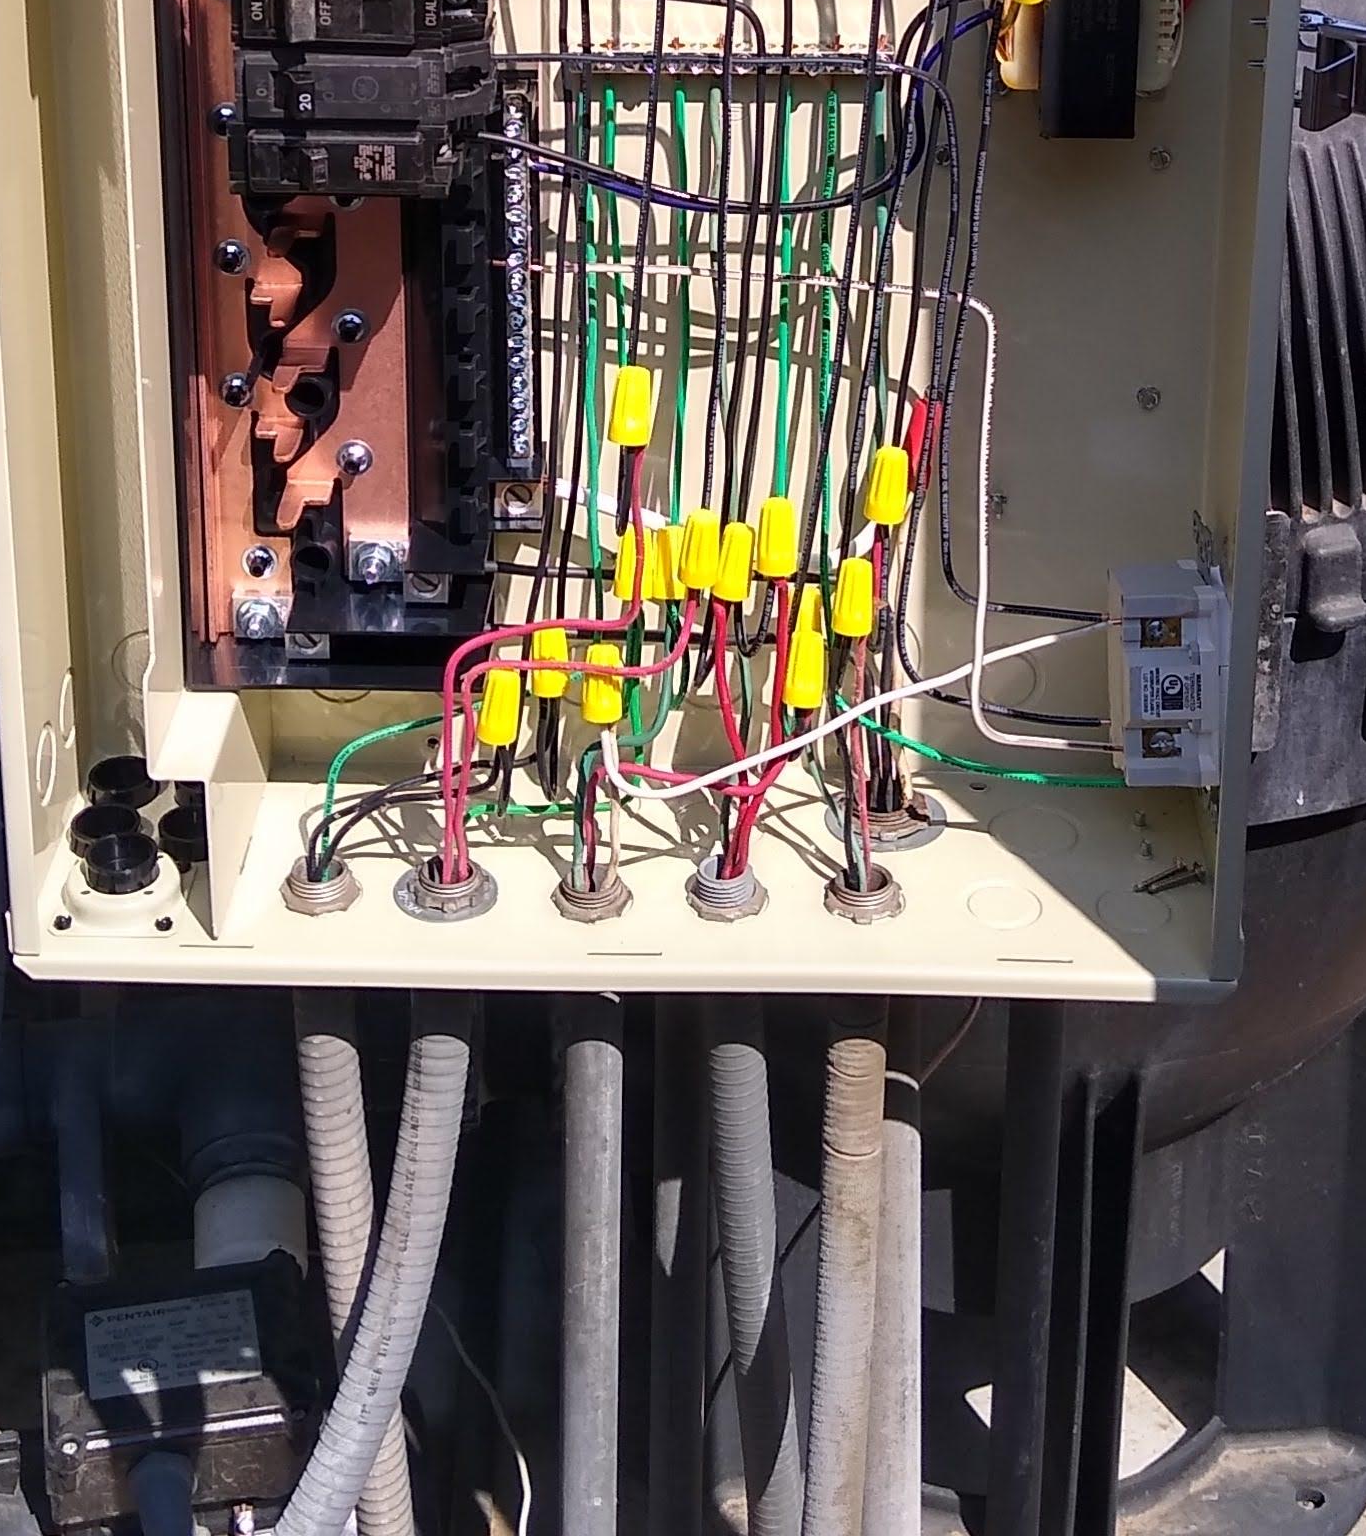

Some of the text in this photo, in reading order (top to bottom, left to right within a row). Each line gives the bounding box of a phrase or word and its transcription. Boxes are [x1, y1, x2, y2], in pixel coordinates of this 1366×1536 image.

[252, 1, 263, 20] ON
[320, 0, 331, 25] OFF
[300, 94, 312, 110] 20
